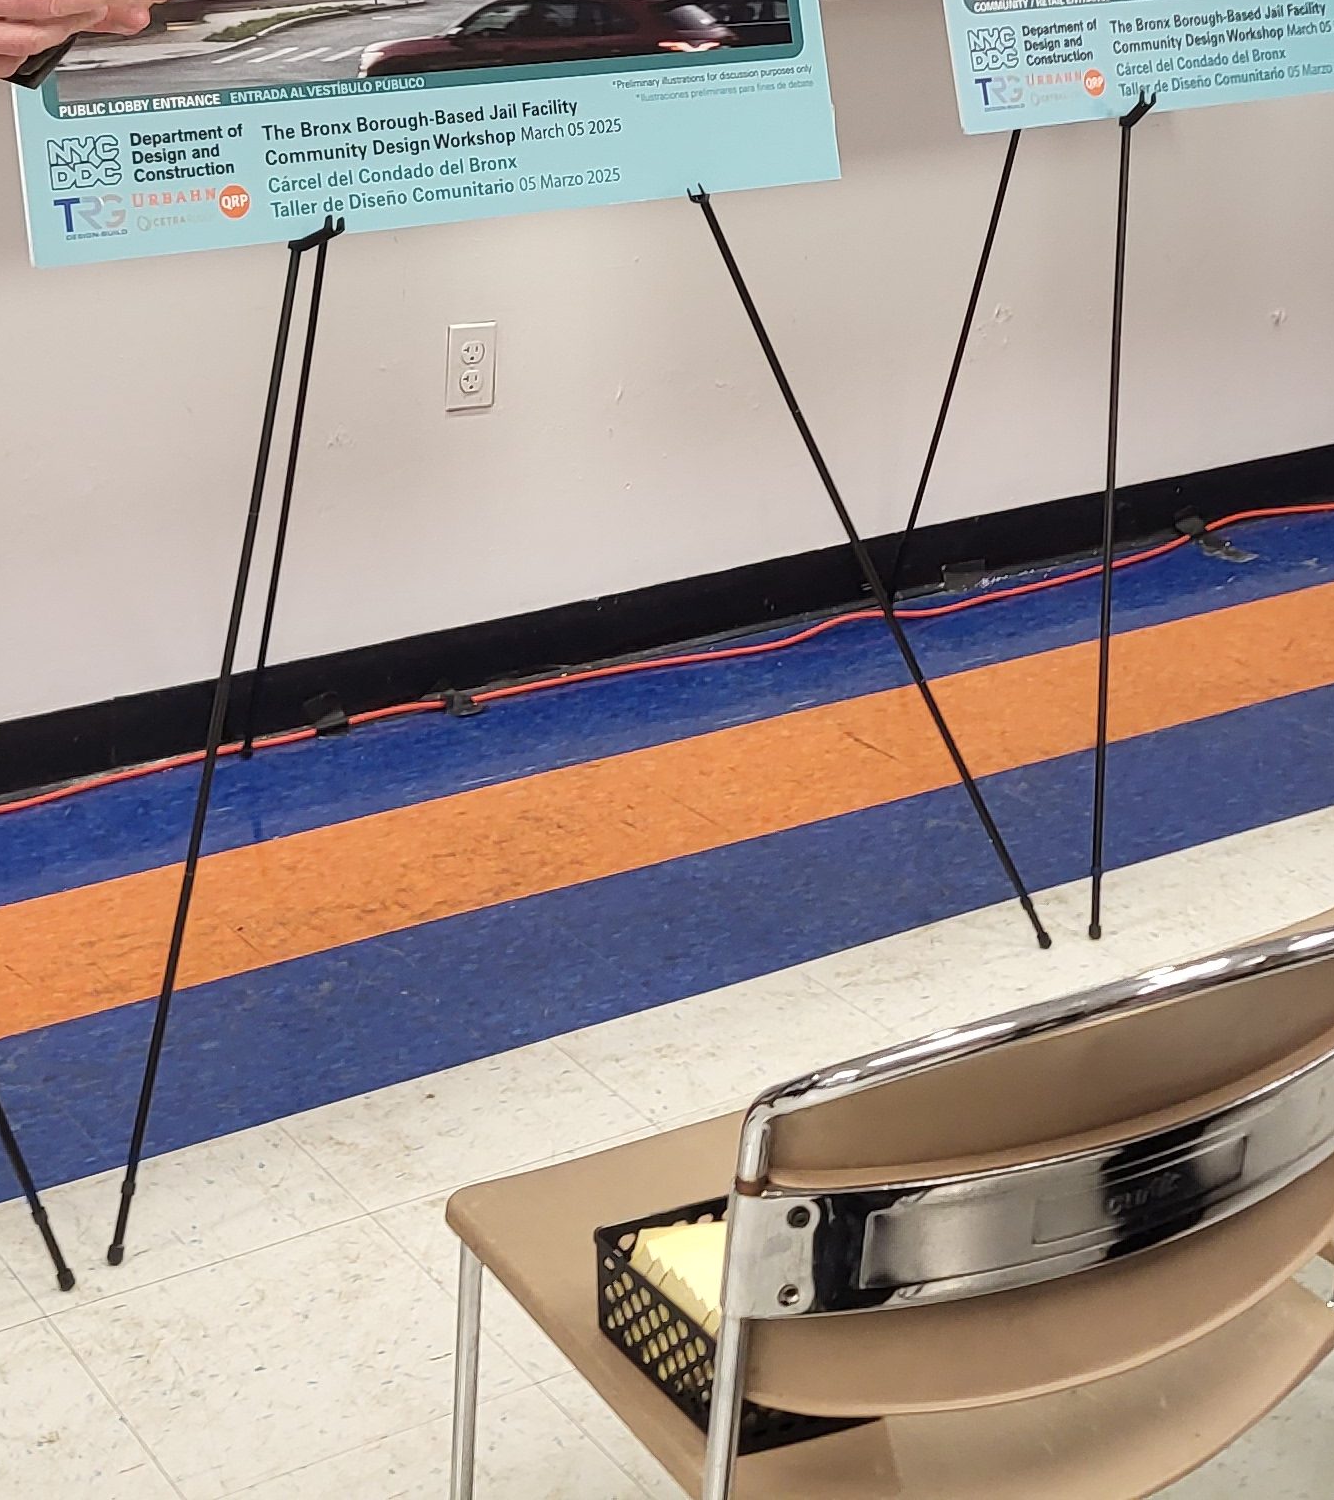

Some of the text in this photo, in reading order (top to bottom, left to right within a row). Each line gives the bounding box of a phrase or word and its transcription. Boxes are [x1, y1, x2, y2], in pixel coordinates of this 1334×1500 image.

[1109, 1, 1326, 34] The Bronx Borough-Based Jail Facility
[661, 74, 707, 86] illustrations
[705, 72, 717, 81] for
[718, 70, 761, 82] discussion
[760, 66, 797, 78] purposes
[796, 63, 812, 74] only
[261, 98, 577, 140] The Bronx Borough-Based Jail Facility
[47, 135, 119, 165] NYC
[265, 118, 621, 165] Community Design Workshop March 05 2025
[50, 160, 122, 190] DDC
[268, 157, 517, 193] Cárcel del Condado del Bronx
[221, 194, 248, 210] QRP
[270, 167, 620, 218] Taller de Diseño Comunitario 05 Marzo 2025
